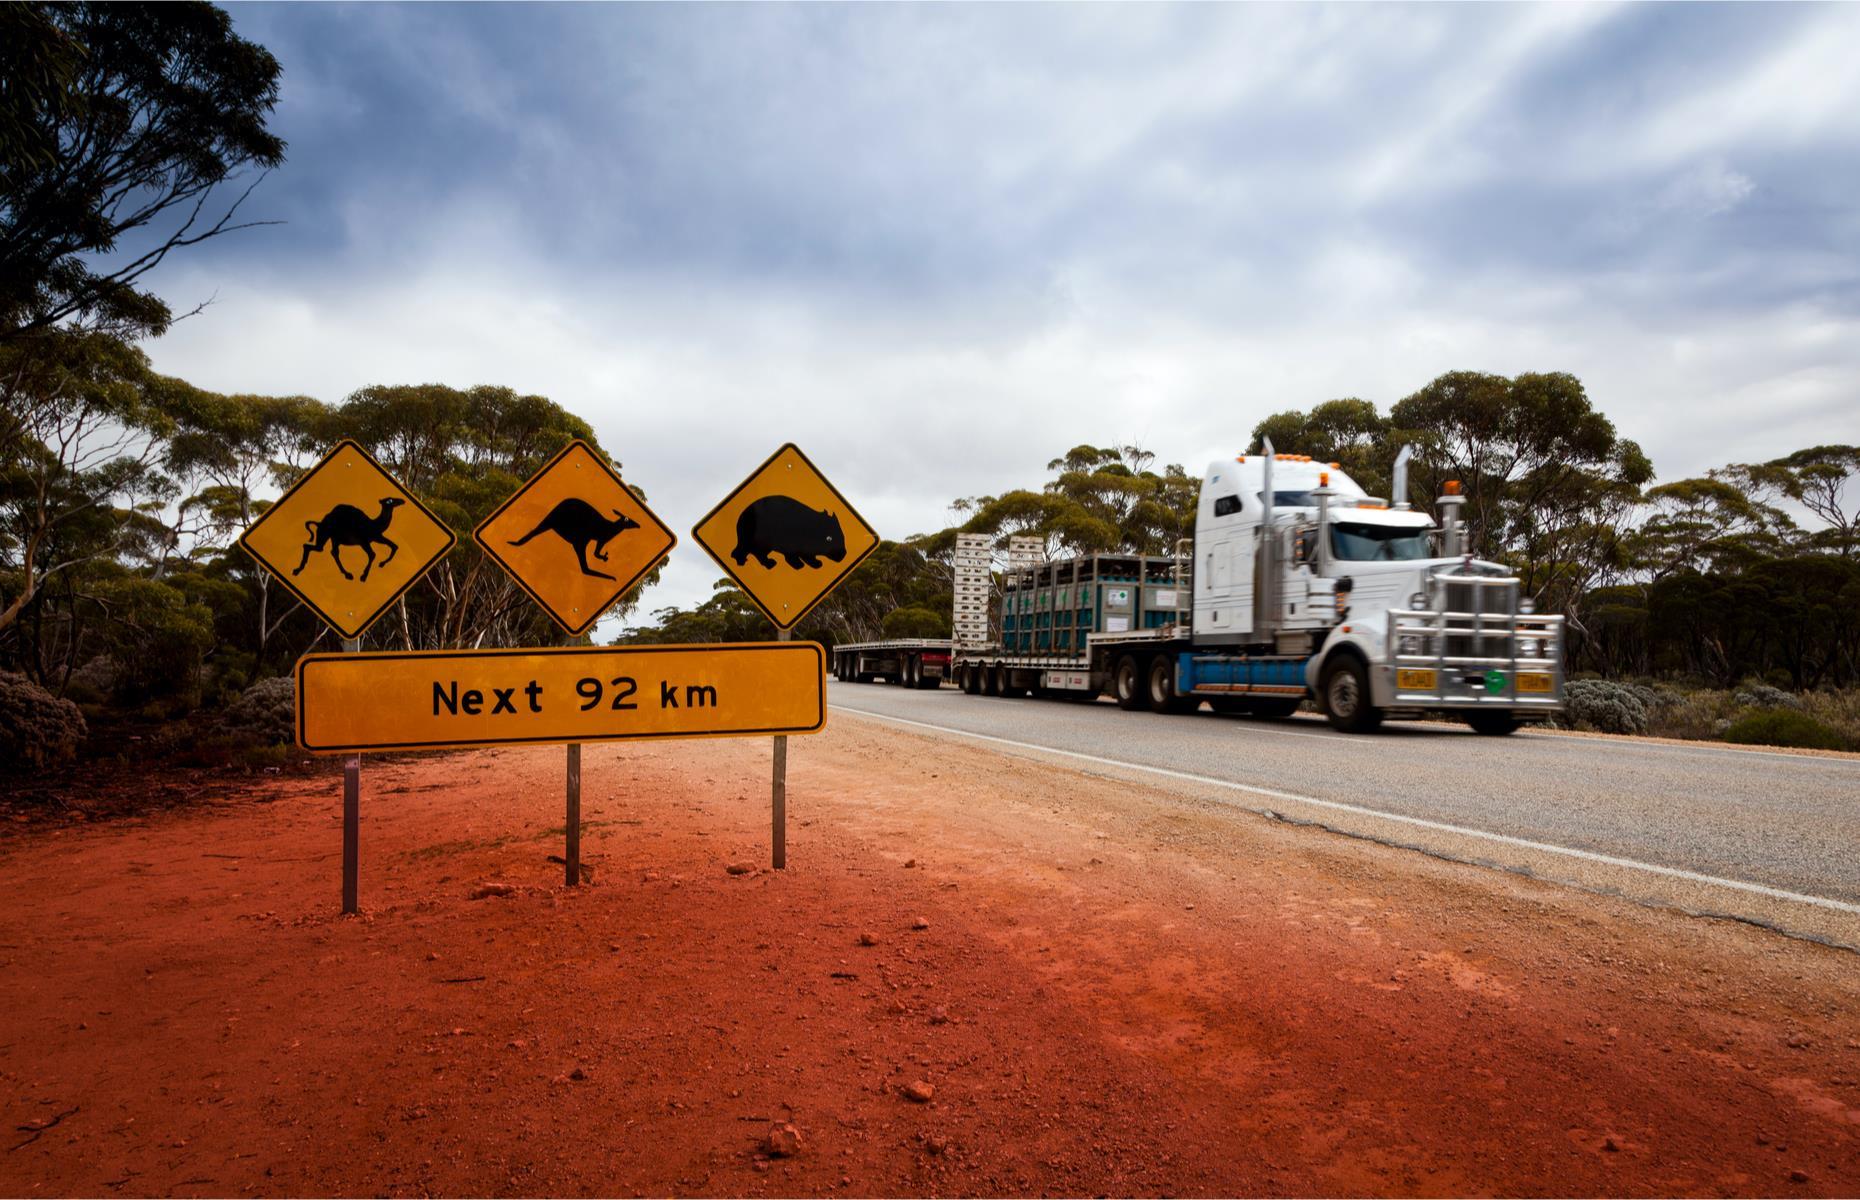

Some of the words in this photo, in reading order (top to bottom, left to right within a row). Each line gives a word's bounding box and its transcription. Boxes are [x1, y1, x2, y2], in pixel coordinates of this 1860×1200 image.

[433, 680, 543, 716] Next
[575, 676, 638, 712] 92
[661, 680, 717, 710] km
